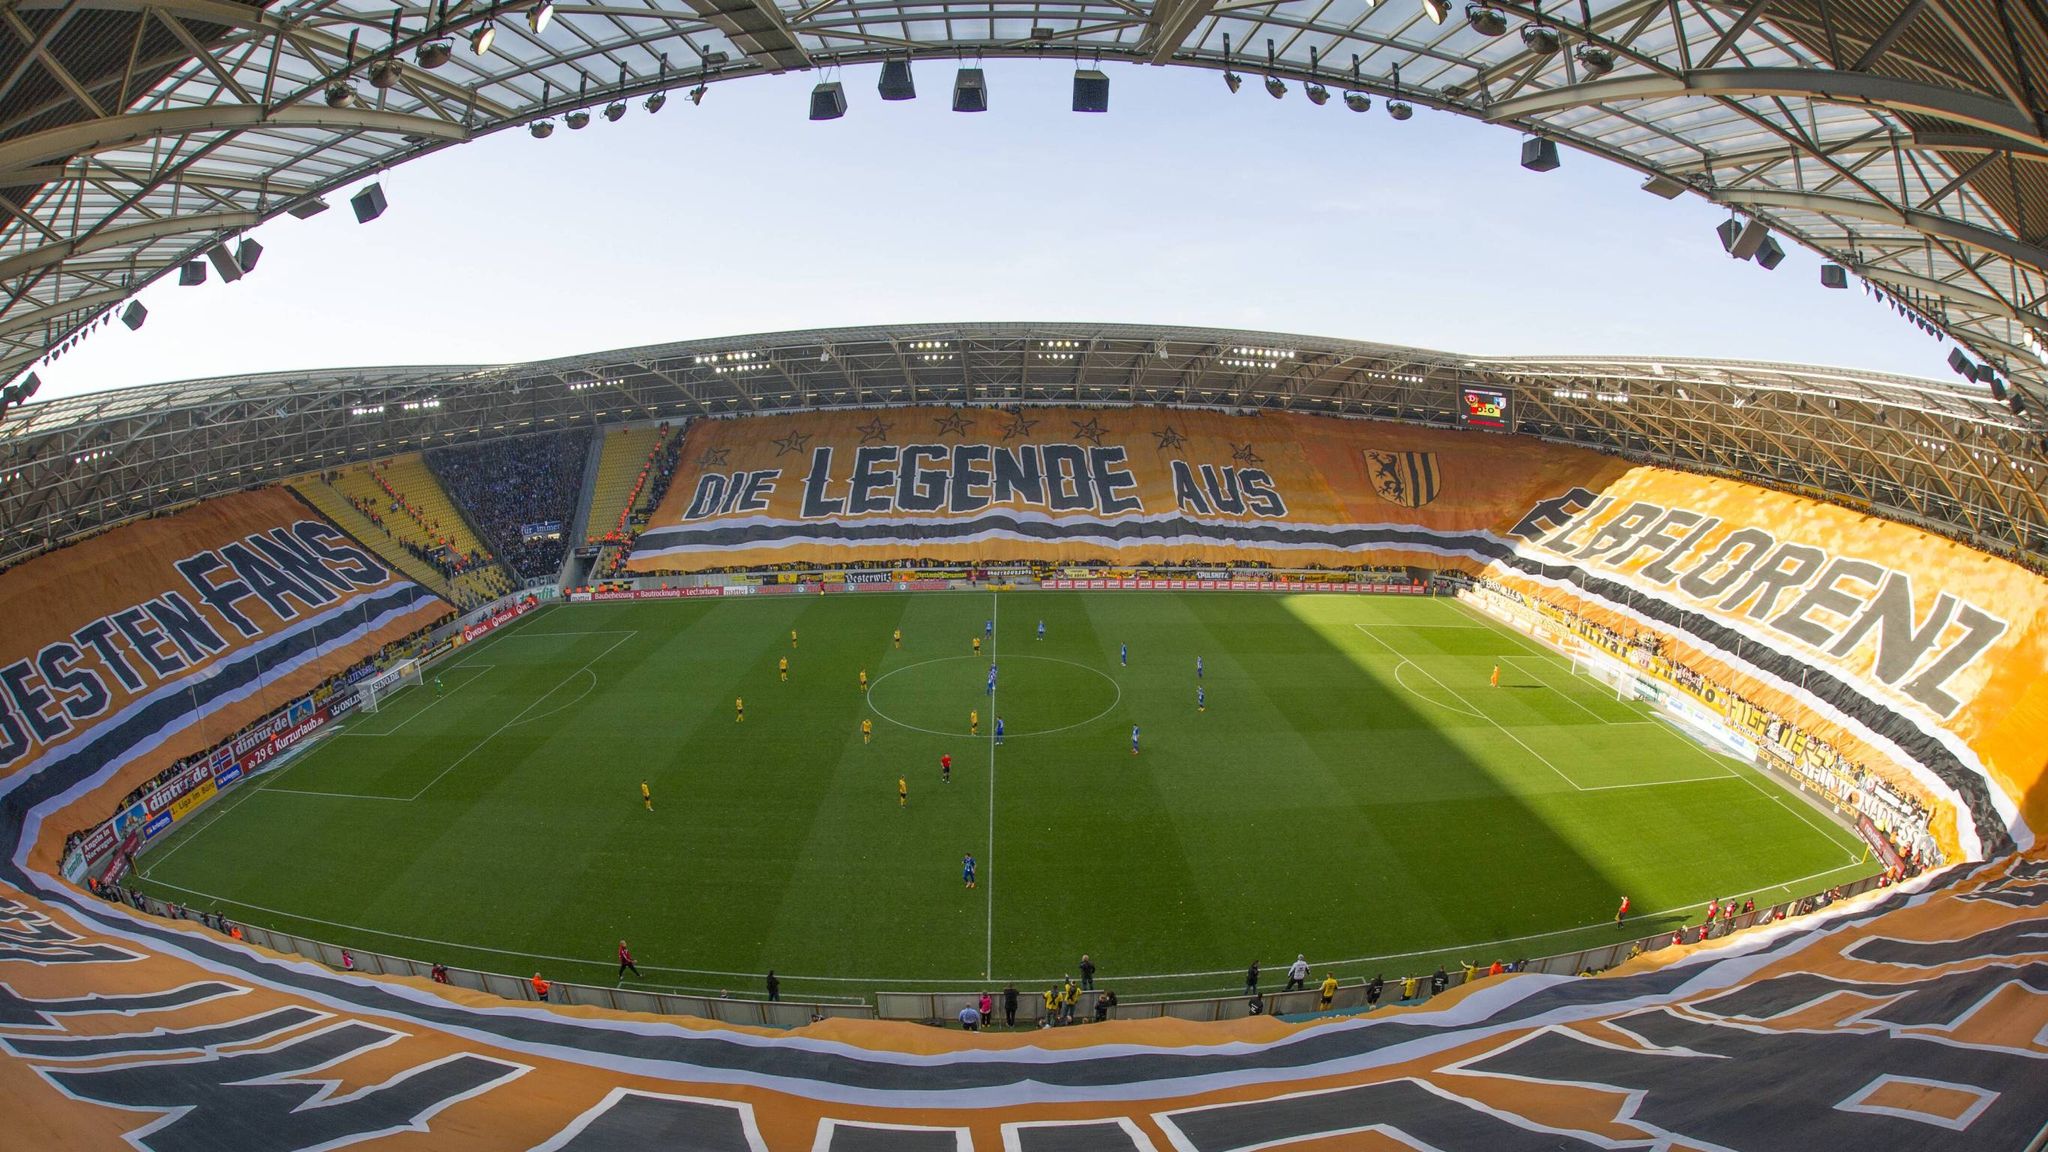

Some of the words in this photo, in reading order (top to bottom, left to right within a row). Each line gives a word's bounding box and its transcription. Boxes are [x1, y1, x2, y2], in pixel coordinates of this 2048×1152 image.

[681, 469, 783, 521] DIE
[800, 443, 1145, 518] LEGENDE
[1169, 459, 1290, 518] AUS
[173, 520, 390, 637] FANS
[594, 591, 634, 600] Baubeheizung
[640, 589, 680, 599] Bautrocknung
[1507, 486, 2009, 721] ELBFLORENZ
[498, 612, 512, 623] VEOLIA
[472, 625, 488, 637] VEOLIA
[235, 716, 288, 756] dintur.de
[255, 746, 267, 764] 29
[267, 743, 274, 756] €
[275, 717, 324, 752] Kurzurlaub.de
[179, 799, 192, 812] Liga
[84, 833, 104, 853] Angeln
[85, 836, 114, 862] Norwegen
